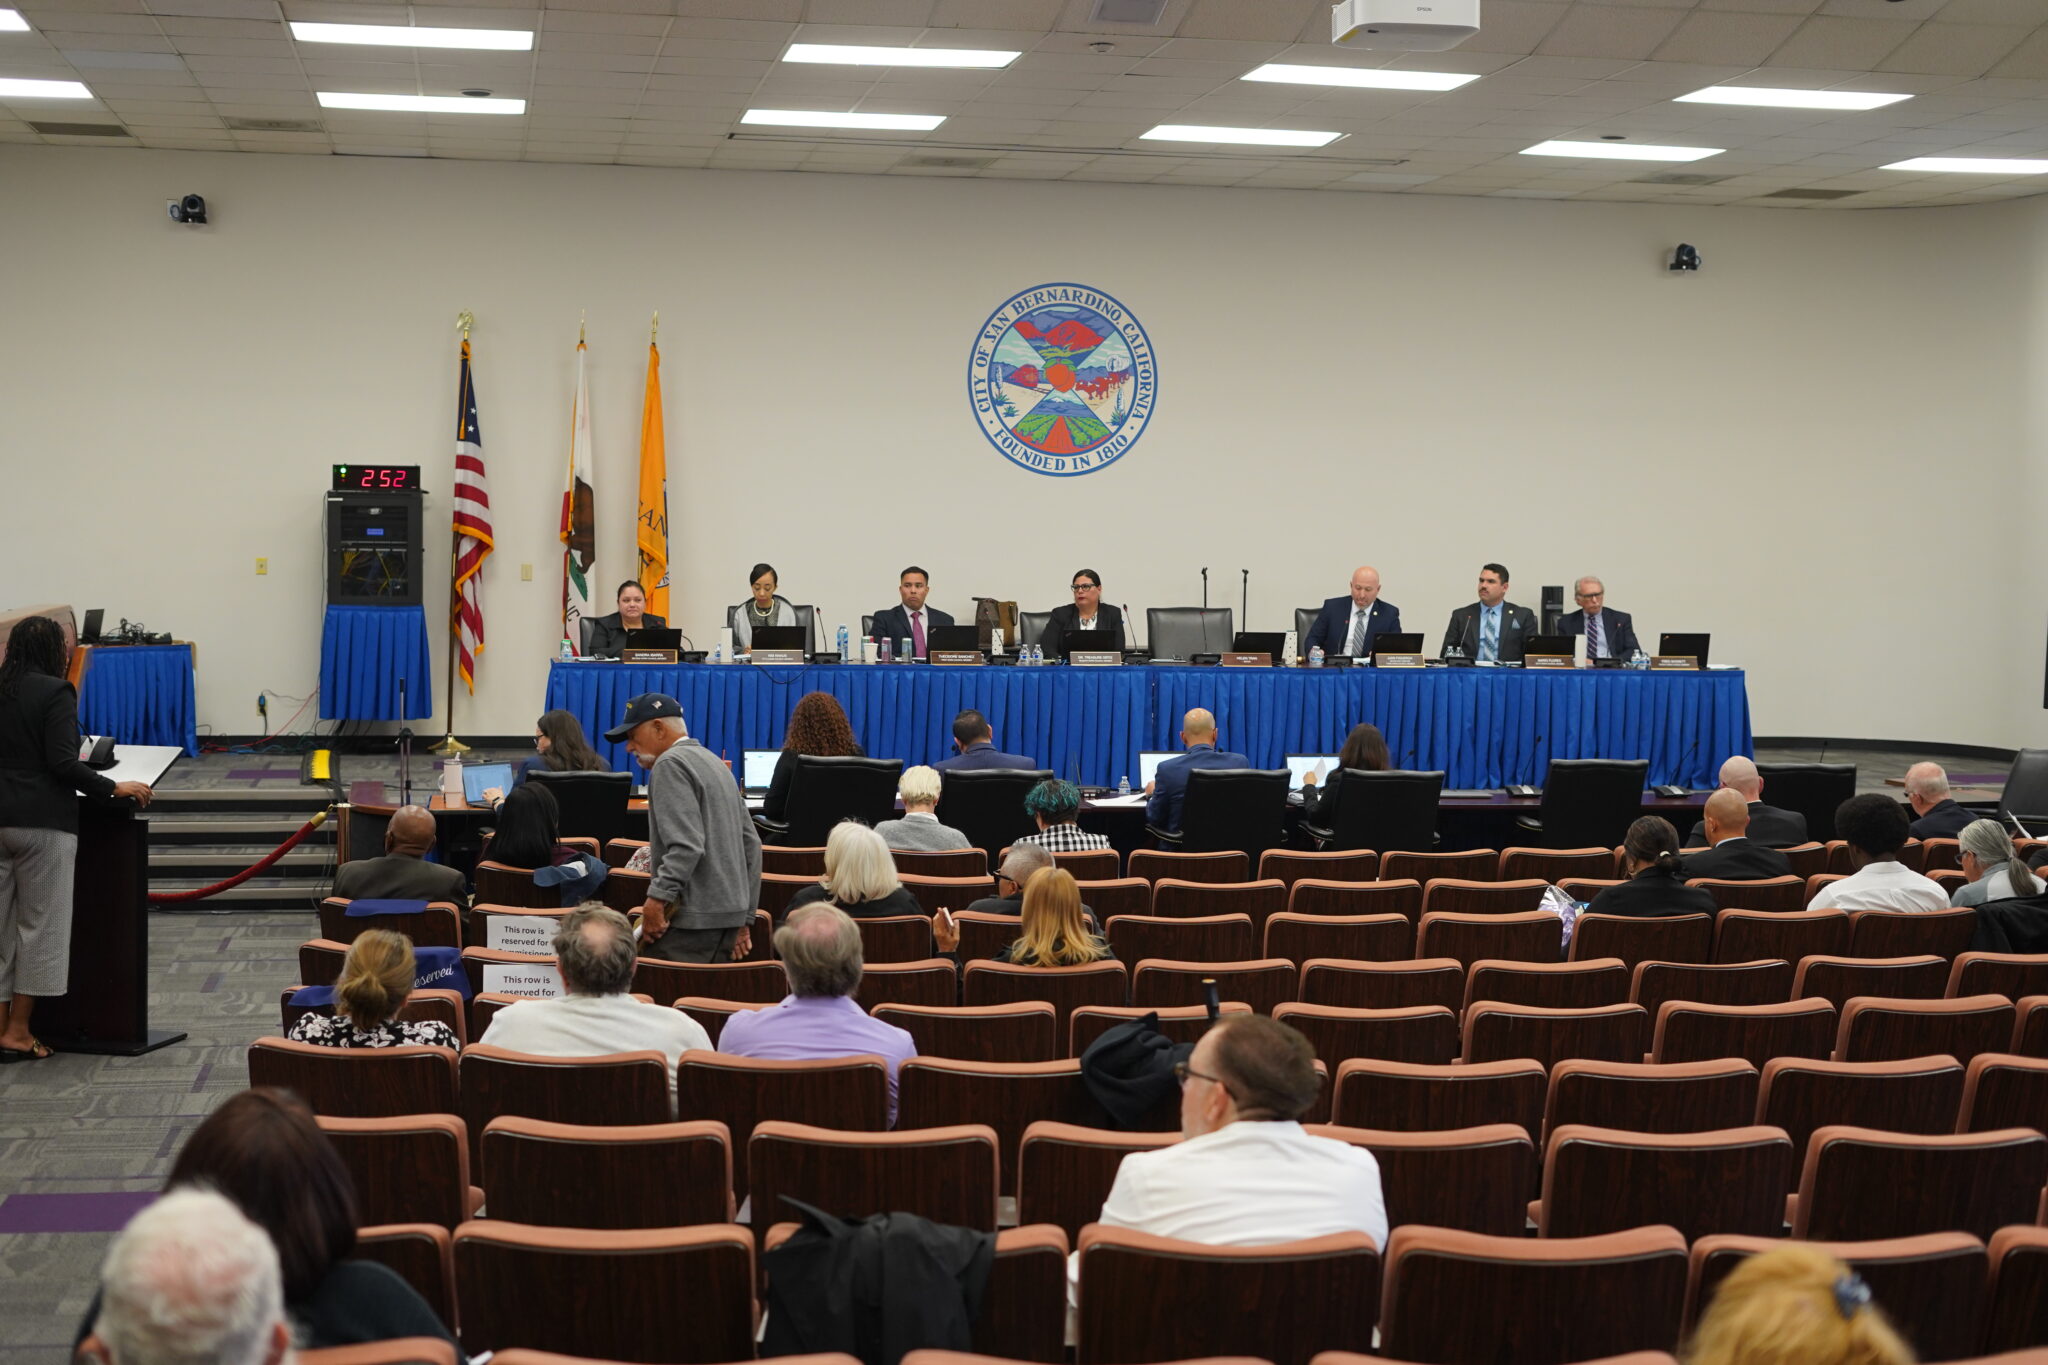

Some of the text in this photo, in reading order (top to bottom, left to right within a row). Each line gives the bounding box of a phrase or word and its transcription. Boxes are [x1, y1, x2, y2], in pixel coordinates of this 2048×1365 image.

[983, 313, 1010, 343] SAN
[975, 346, 988, 368] OF
[1122, 323, 1152, 420] CALIFORNIA
[973, 375, 991, 413] CITY
[993, 428, 1128, 471] FOUNDED IN 1810
[504, 926, 520, 934] This
[538, 927, 545, 935] is
[414, 963, 455, 988] eserved
[503, 976, 522, 984] This
[543, 976, 551, 984] is
[542, 989, 556, 997] for
